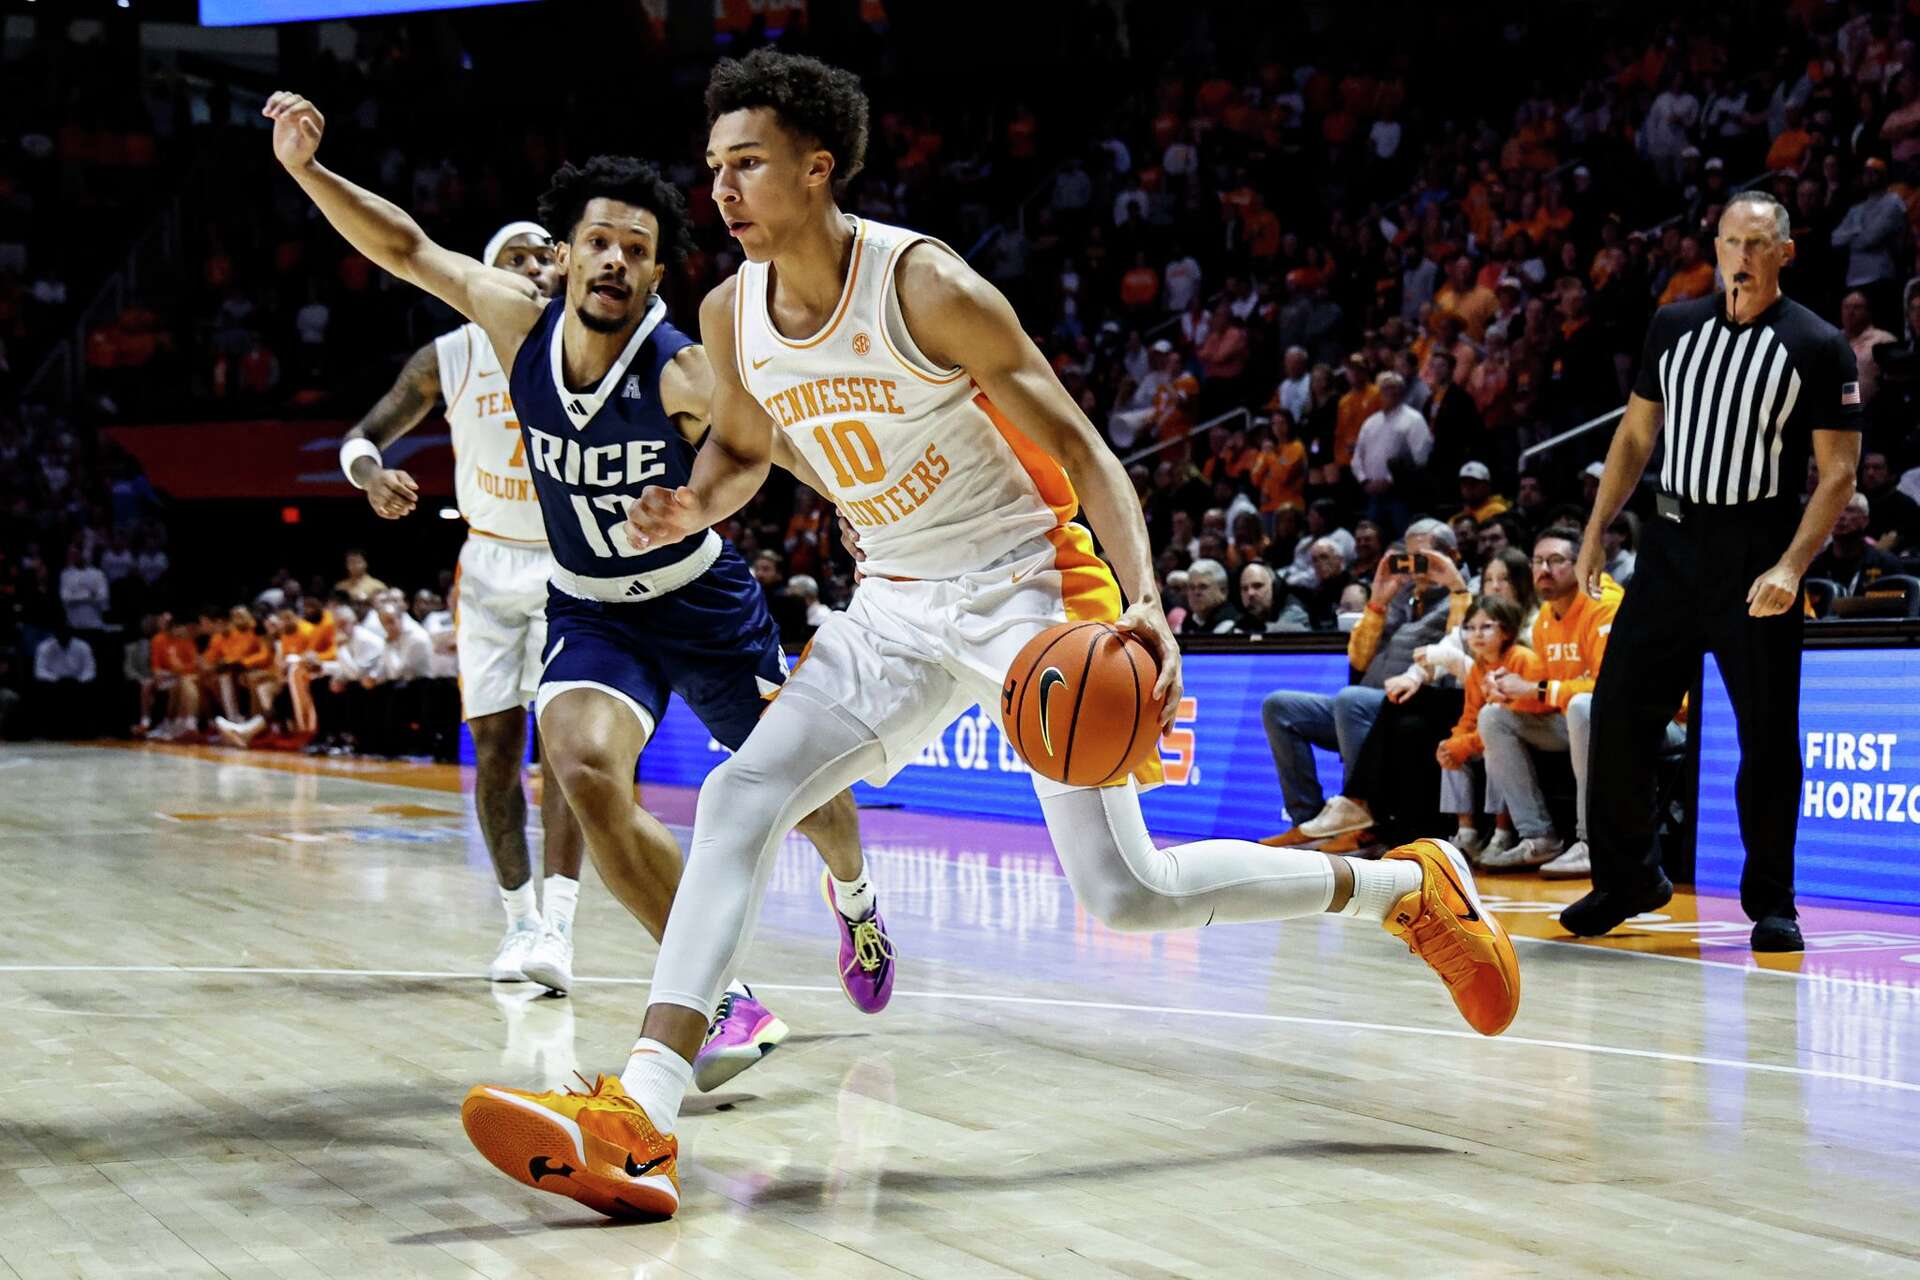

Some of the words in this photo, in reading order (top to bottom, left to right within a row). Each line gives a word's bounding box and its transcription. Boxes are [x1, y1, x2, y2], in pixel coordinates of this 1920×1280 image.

[622, 374, 641, 399] A
[503, 420, 526, 468] 7
[527, 425, 666, 487] RICE
[813, 420, 887, 488] 10
[846, 442, 950, 526] UNTEERS
[569, 493, 684, 558] 12
[1805, 732, 1897, 771] FIRST
[1803, 780, 1920, 825] HORIZO
